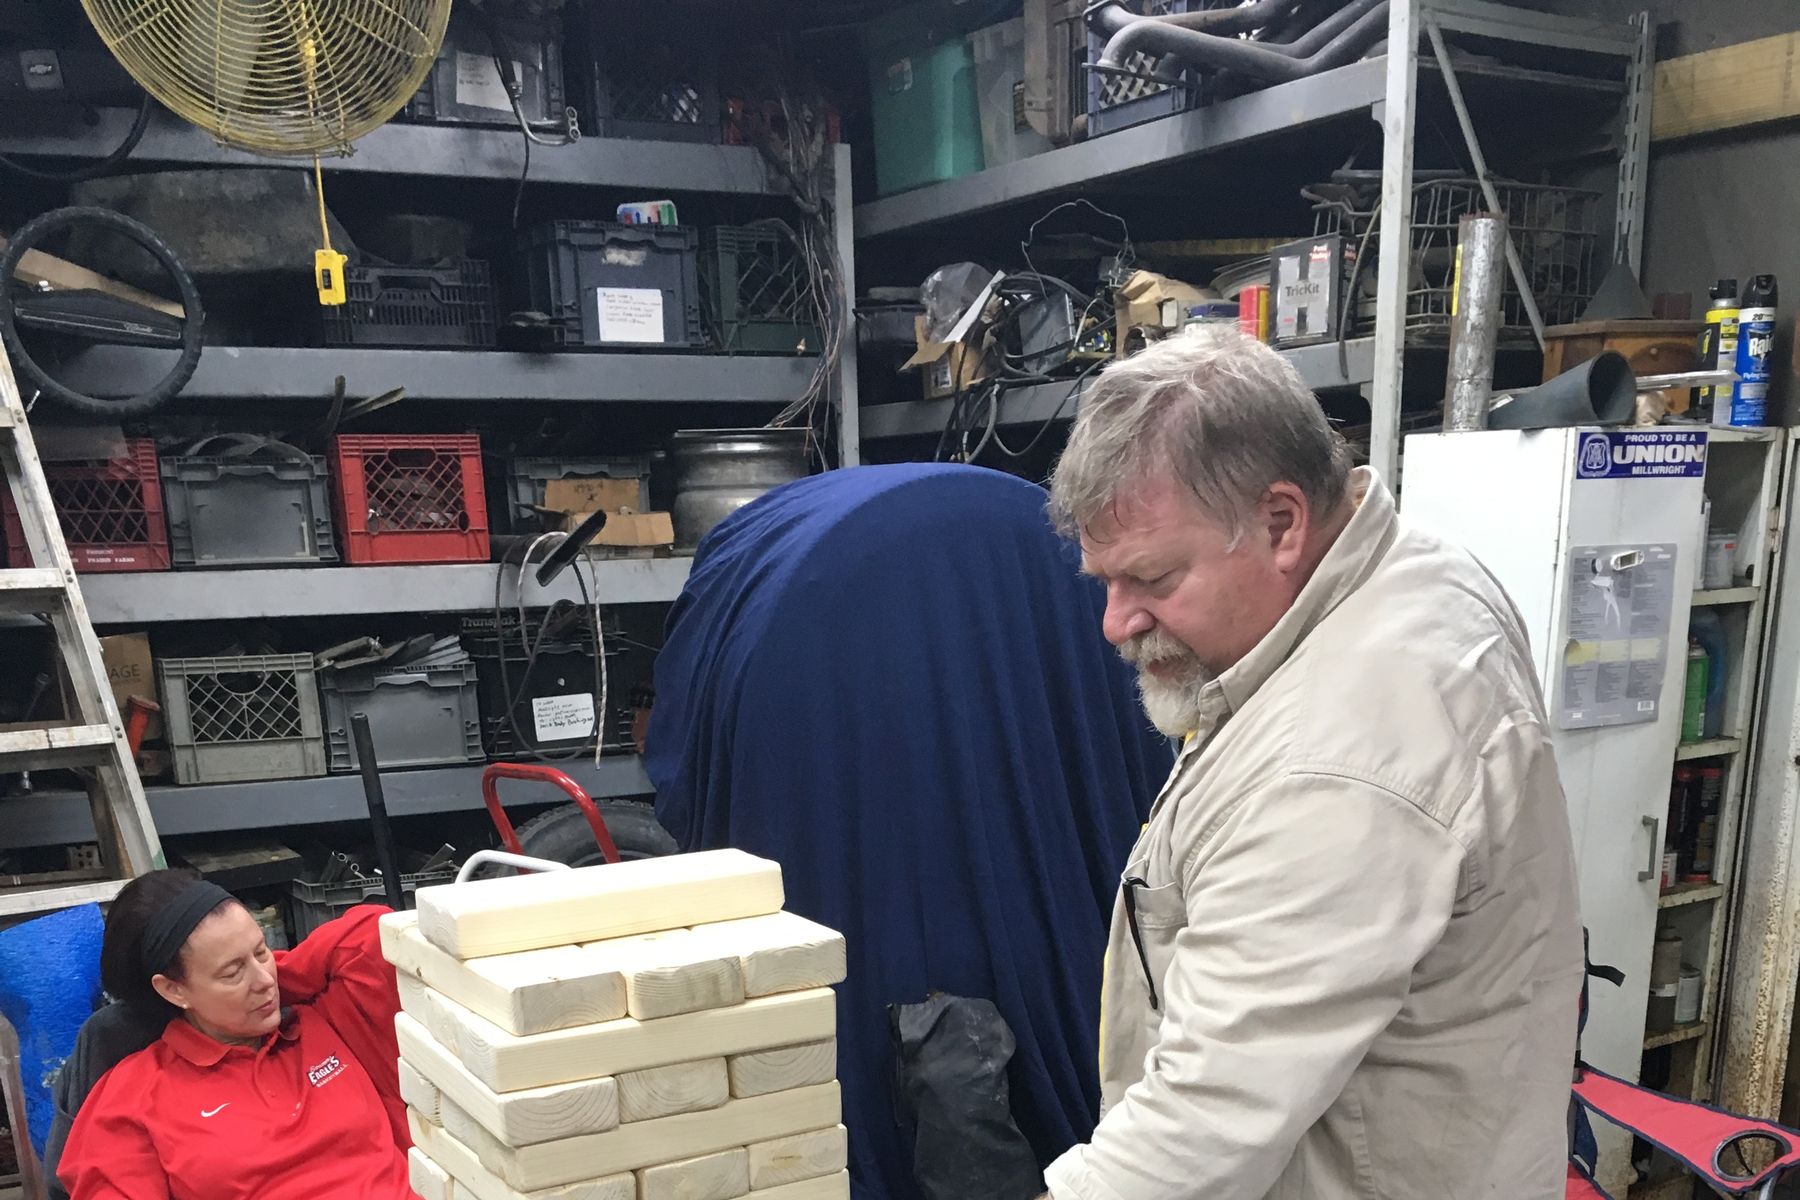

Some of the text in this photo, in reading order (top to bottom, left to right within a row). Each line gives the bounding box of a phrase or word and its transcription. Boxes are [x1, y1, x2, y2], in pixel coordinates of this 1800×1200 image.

[1285, 283, 1320, 297] TricKit
[1624, 434, 1696, 442] PROUD TO BE A
[1612, 444, 1705, 464] UNION
[1632, 465, 1687, 475] MILLWRIGHT
[308, 1056, 340, 1085] EAGLES
